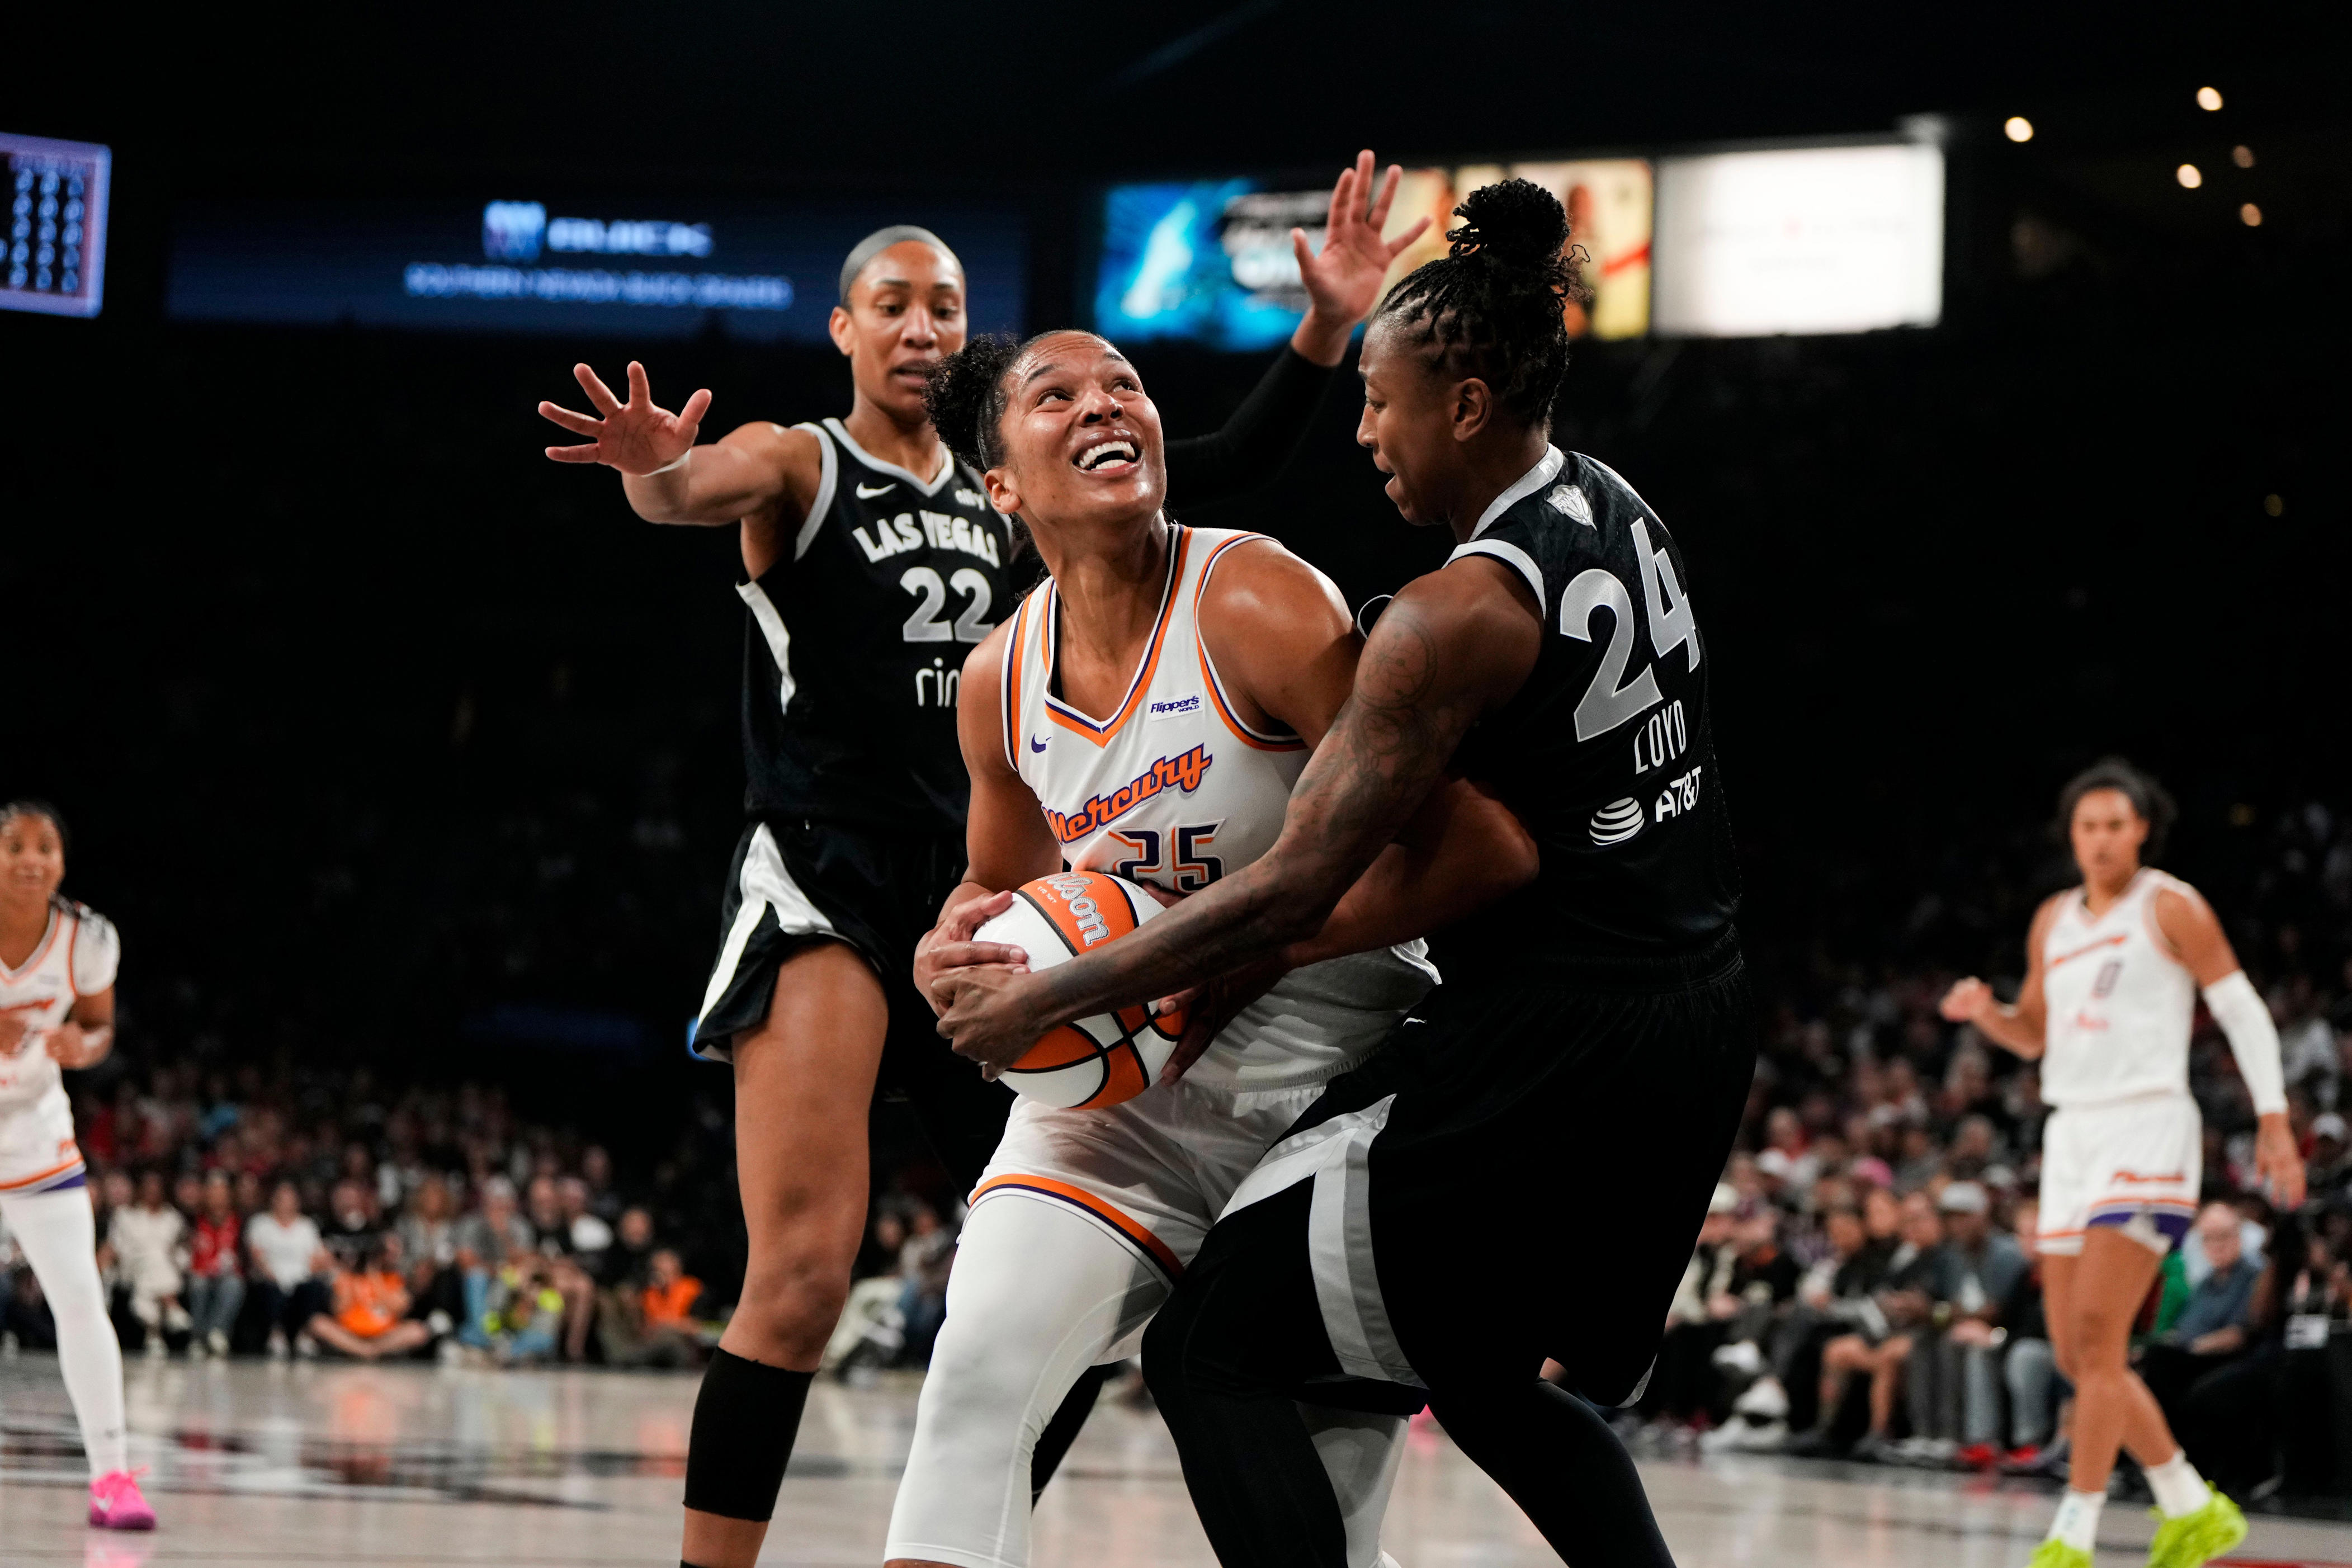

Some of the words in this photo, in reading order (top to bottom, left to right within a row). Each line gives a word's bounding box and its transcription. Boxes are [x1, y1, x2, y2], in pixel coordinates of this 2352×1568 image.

[852, 513, 924, 563] LAS
[919, 509, 1000, 569] VEGAS
[900, 566, 996, 644] 22
[1560, 516, 1700, 742] 24
[915, 657, 961, 707] rin
[1150, 695, 1199, 713] Flipper's
[1634, 700, 1687, 775] LOYD
[1042, 742, 1212, 844] Mercury
[1655, 766, 1701, 823] AT&T
[1108, 819, 1226, 894] 25
